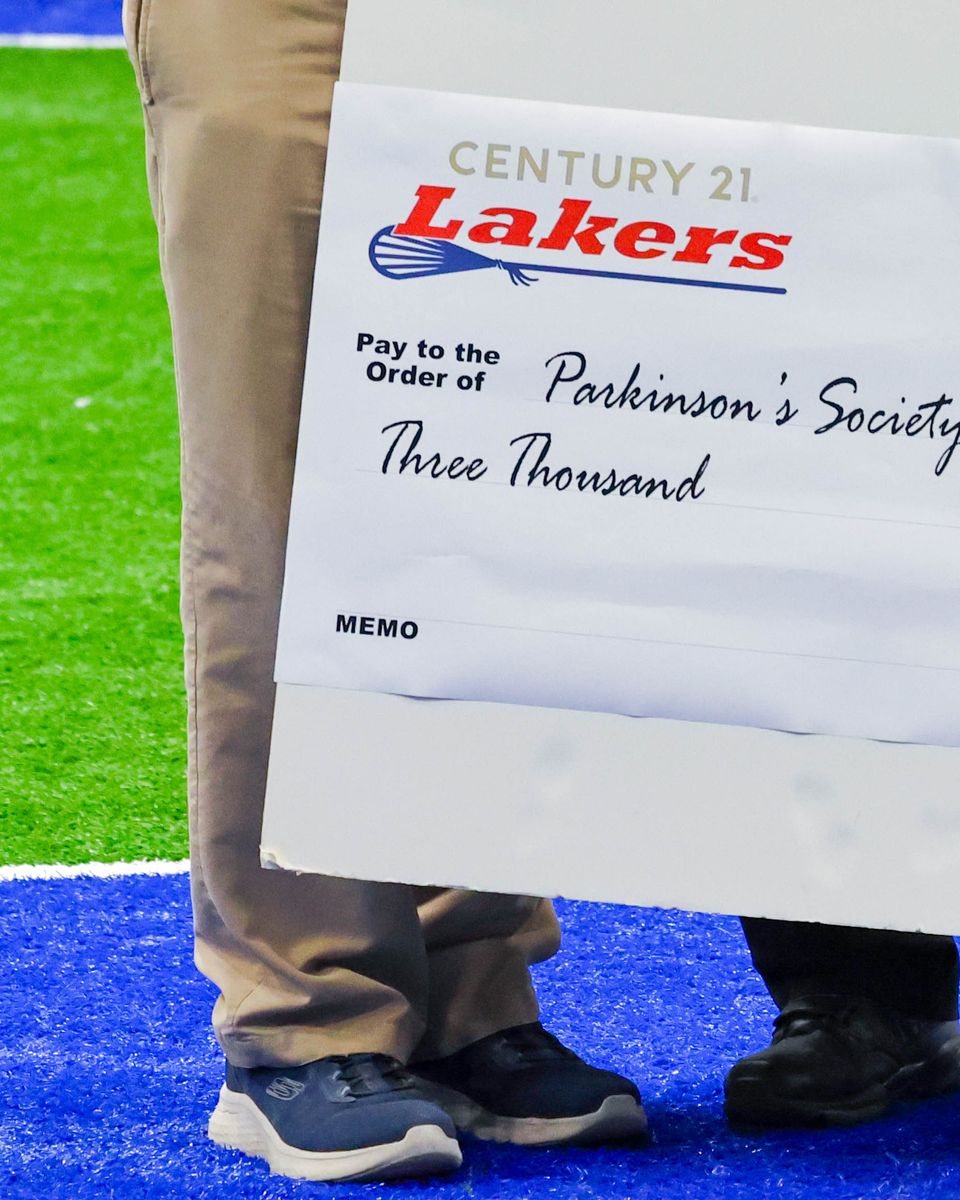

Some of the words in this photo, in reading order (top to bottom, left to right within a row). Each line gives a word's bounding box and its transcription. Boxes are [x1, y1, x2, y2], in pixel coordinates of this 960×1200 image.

[449, 140, 696, 196] CENTURY
[393, 184, 793, 271] Lakers
[356, 332, 408, 361] Pay
[417, 339, 445, 360] to
[455, 343, 501, 366] the
[366, 361, 449, 388] Order
[456, 371, 486, 392] of
[544, 351, 799, 427] Parkinson's
[381, 419, 489, 482] Three
[509, 432, 711, 503] Thousand
[335, 613, 419, 640] MEMO
